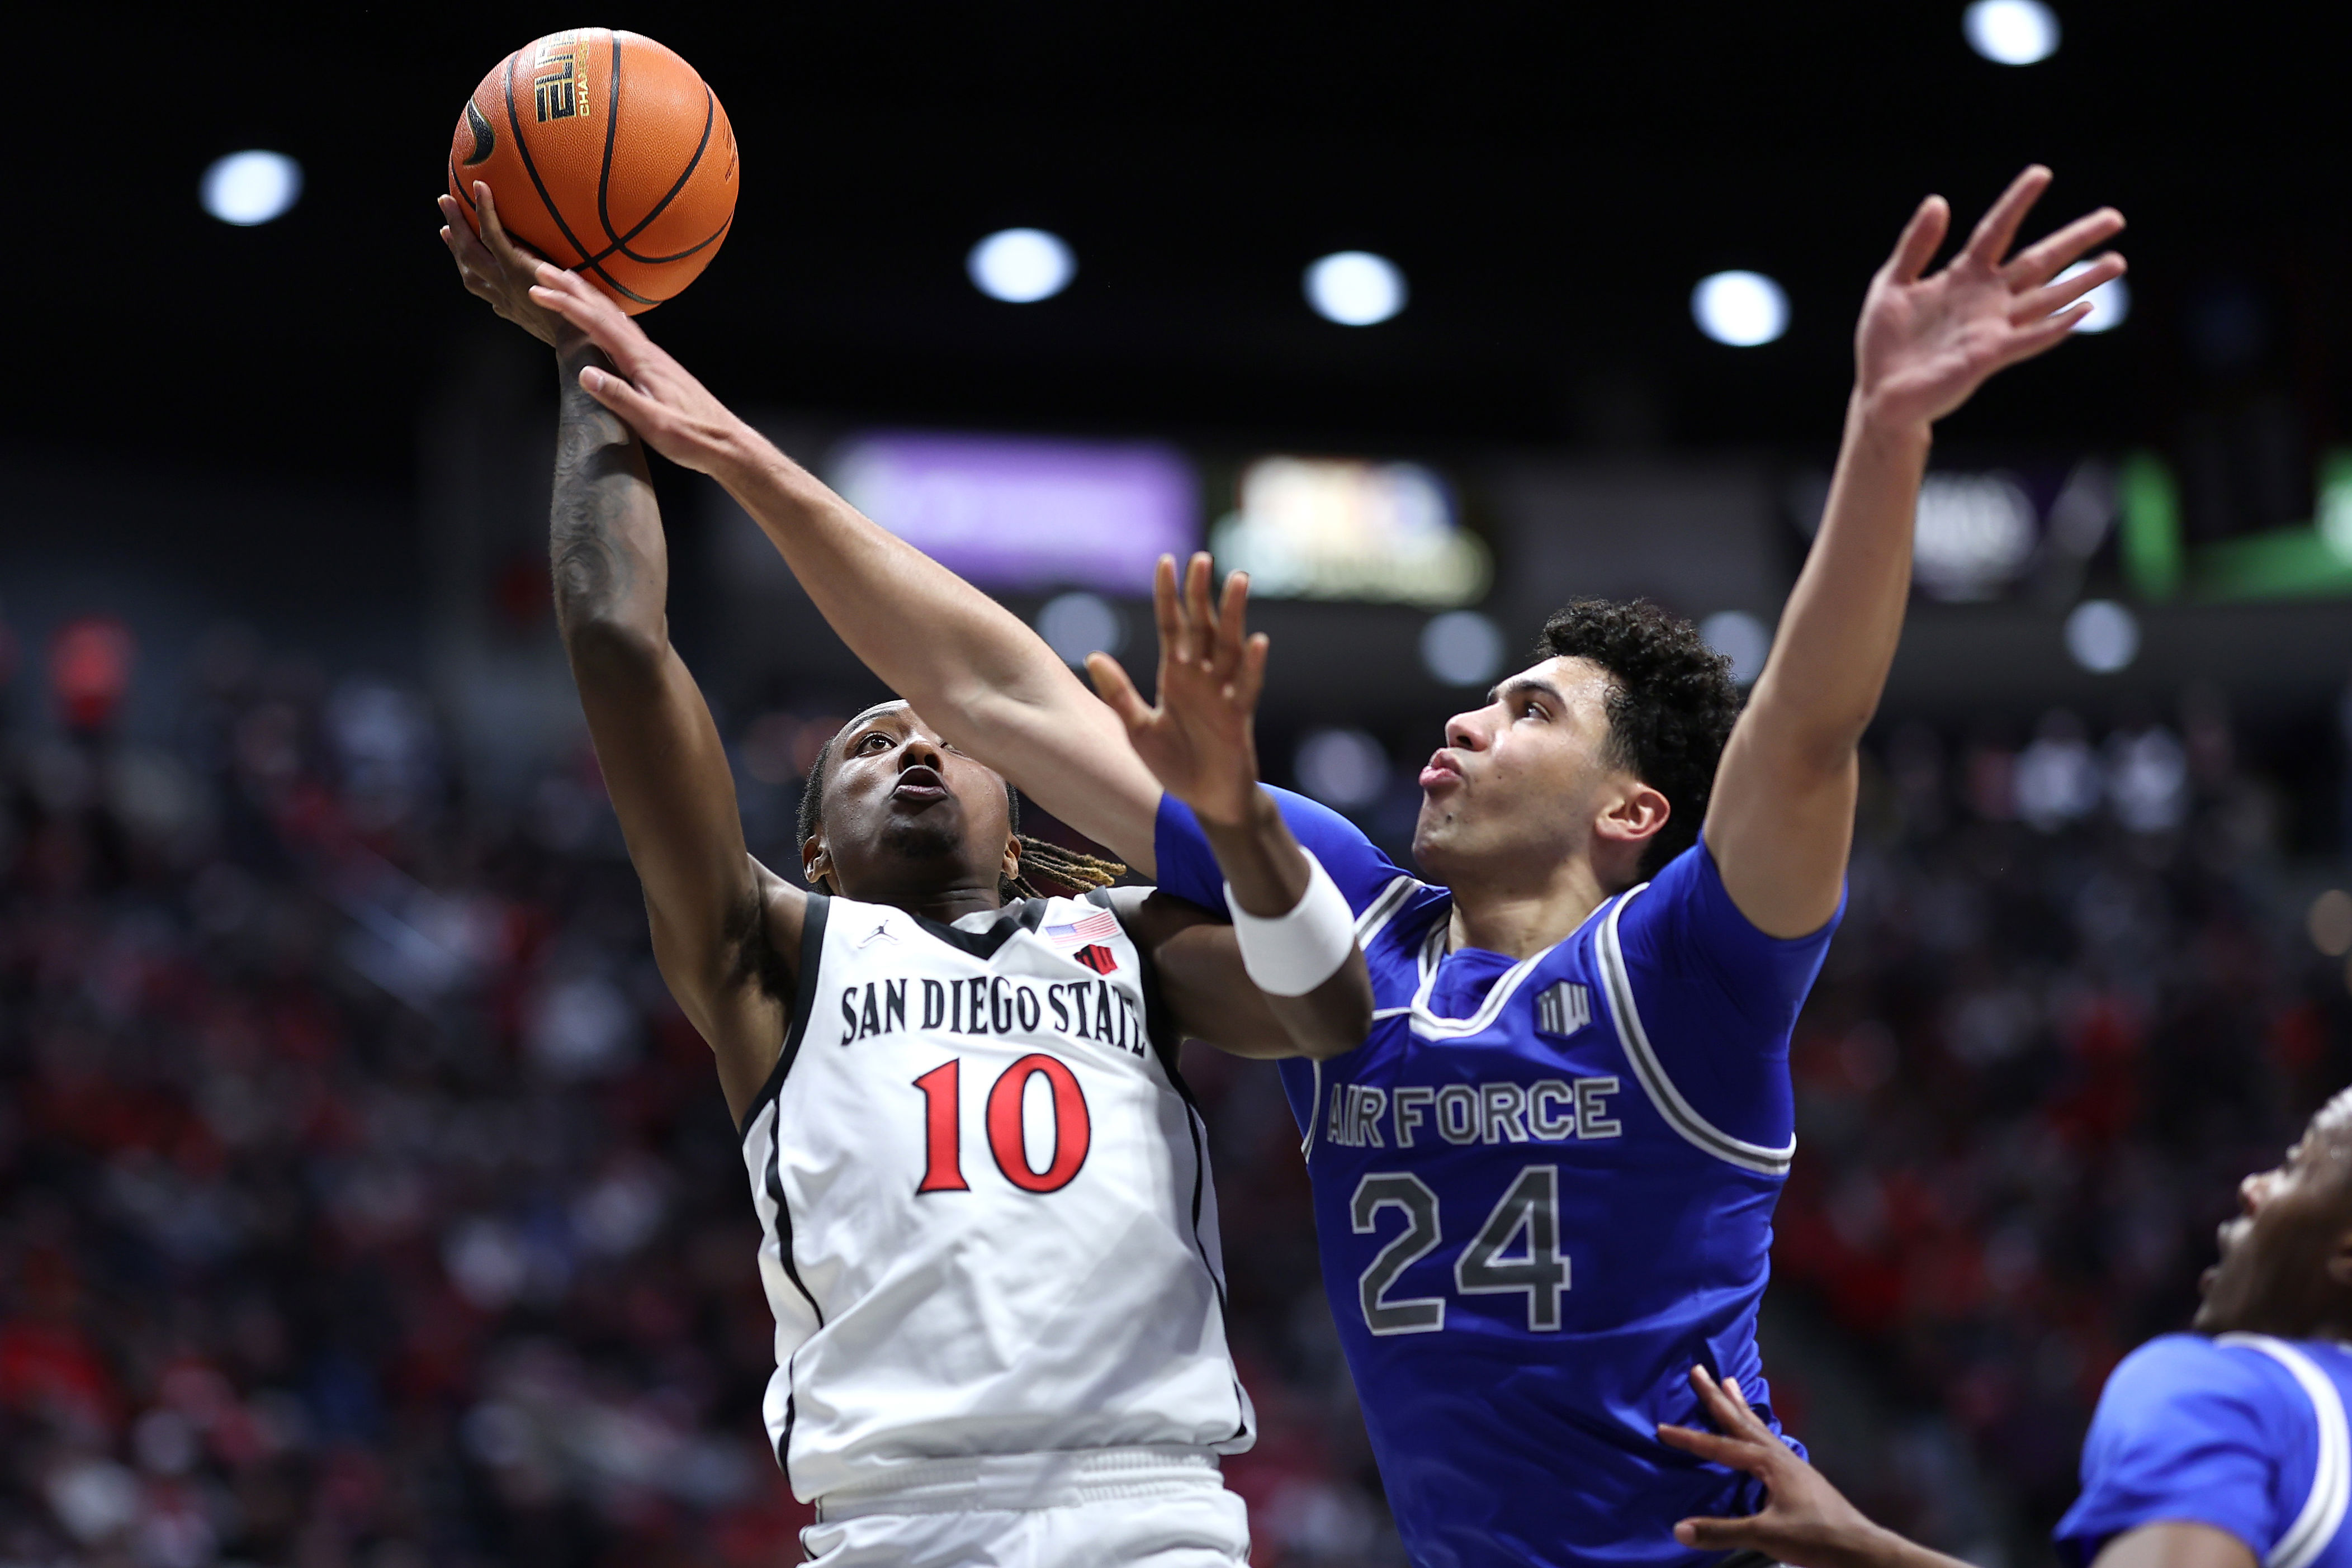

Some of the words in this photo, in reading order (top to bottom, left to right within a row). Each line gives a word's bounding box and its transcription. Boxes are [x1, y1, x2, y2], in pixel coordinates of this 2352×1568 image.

[841, 978, 907, 1046] SAN
[920, 976, 1040, 1035] DIEGO
[912, 1053, 1091, 1196] 10
[1327, 1083, 1388, 1148] AIR
[1393, 1076, 1622, 1148] FORCE
[1350, 1164, 1571, 1336] 24
